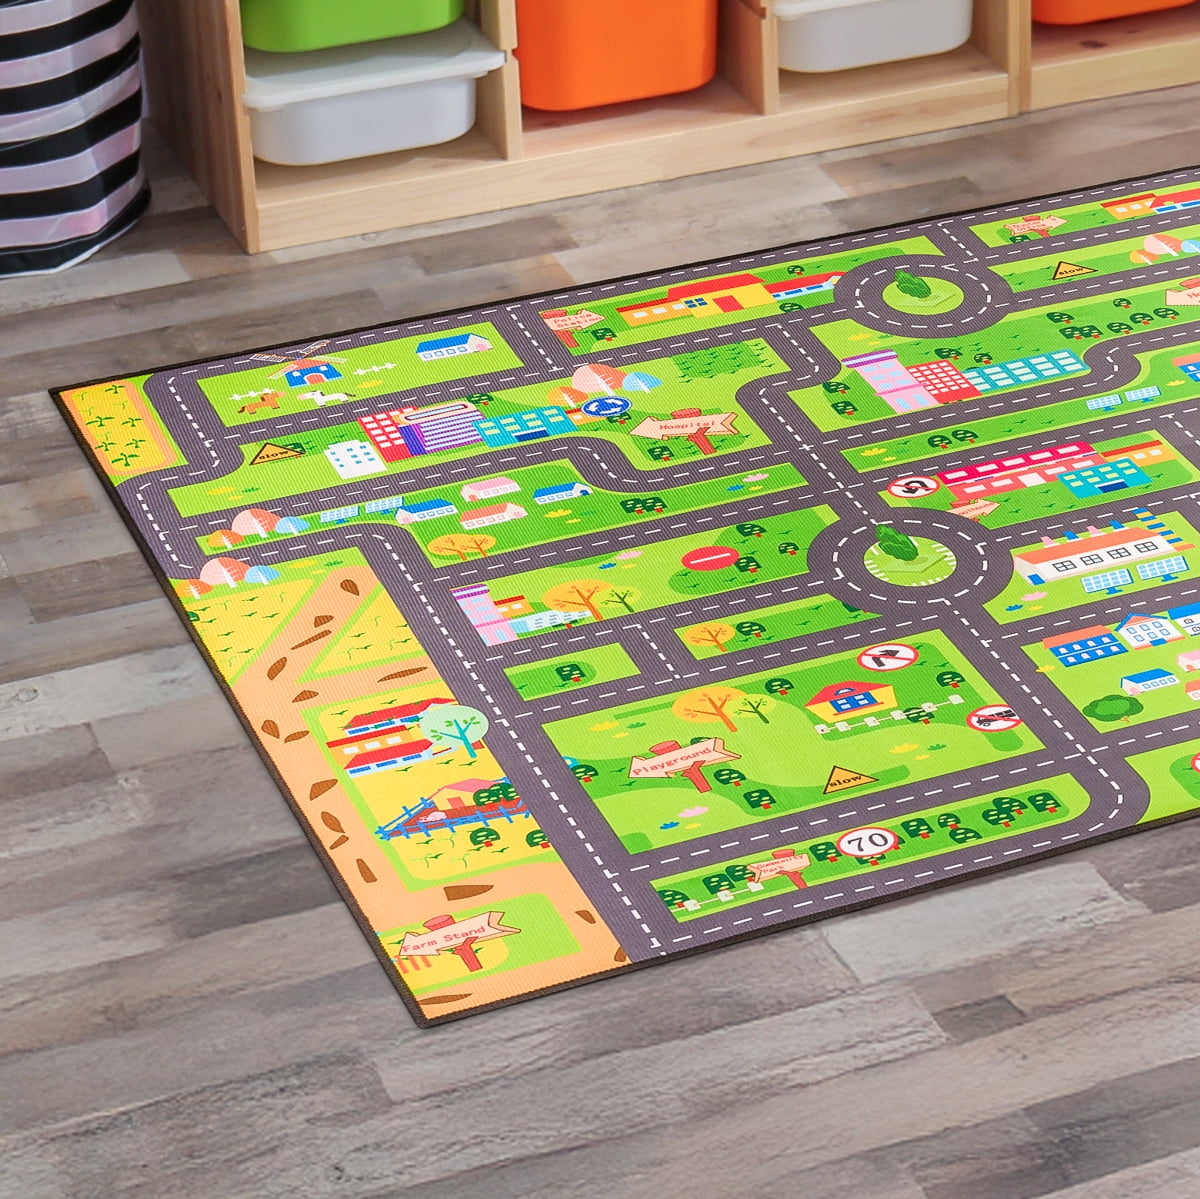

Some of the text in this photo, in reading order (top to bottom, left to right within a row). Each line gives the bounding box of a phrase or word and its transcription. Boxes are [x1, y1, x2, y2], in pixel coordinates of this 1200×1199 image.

[1058, 267, 1084, 276] slow
[659, 420, 716, 431] Hospital
[258, 450, 289, 460] slow
[632, 747, 713, 776] Playground
[830, 775, 862, 788] slow
[847, 832, 889, 852] 70
[756, 853, 804, 869] Community
[763, 864, 785, 874] Park
[402, 925, 486, 953] Farm Stand
